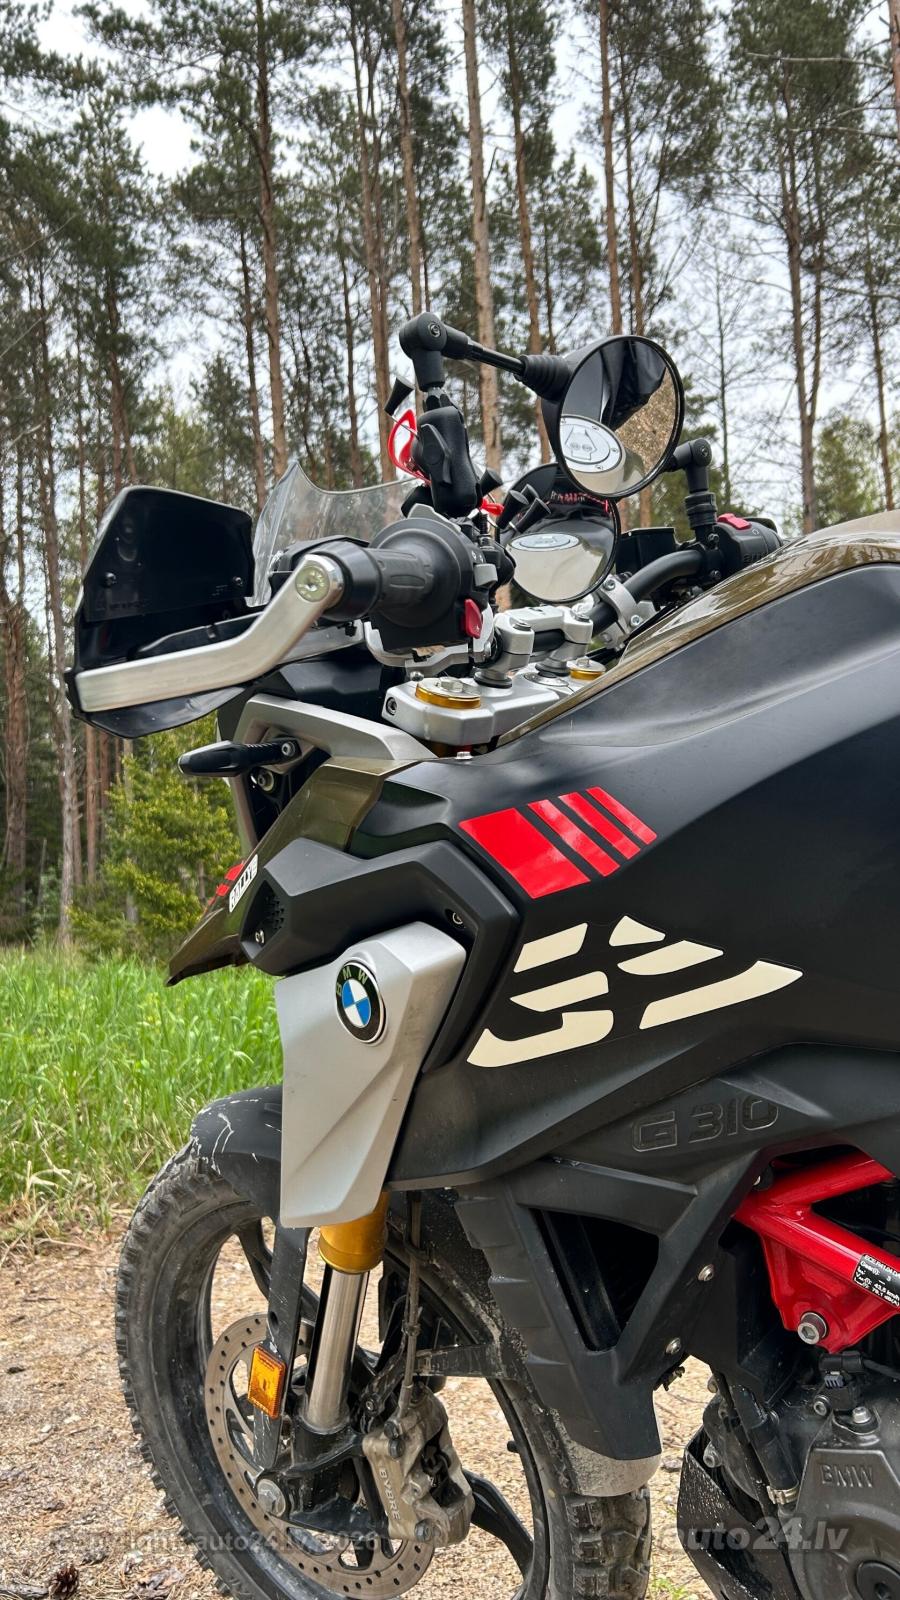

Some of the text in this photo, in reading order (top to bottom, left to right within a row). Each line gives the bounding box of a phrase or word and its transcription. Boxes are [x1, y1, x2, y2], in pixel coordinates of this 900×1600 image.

[336, 965, 369, 997] BMW
[632, 1097, 779, 1152] G 310
[379, 1467, 401, 1520] BYBRE
[820, 1464, 874, 1489] BMW
